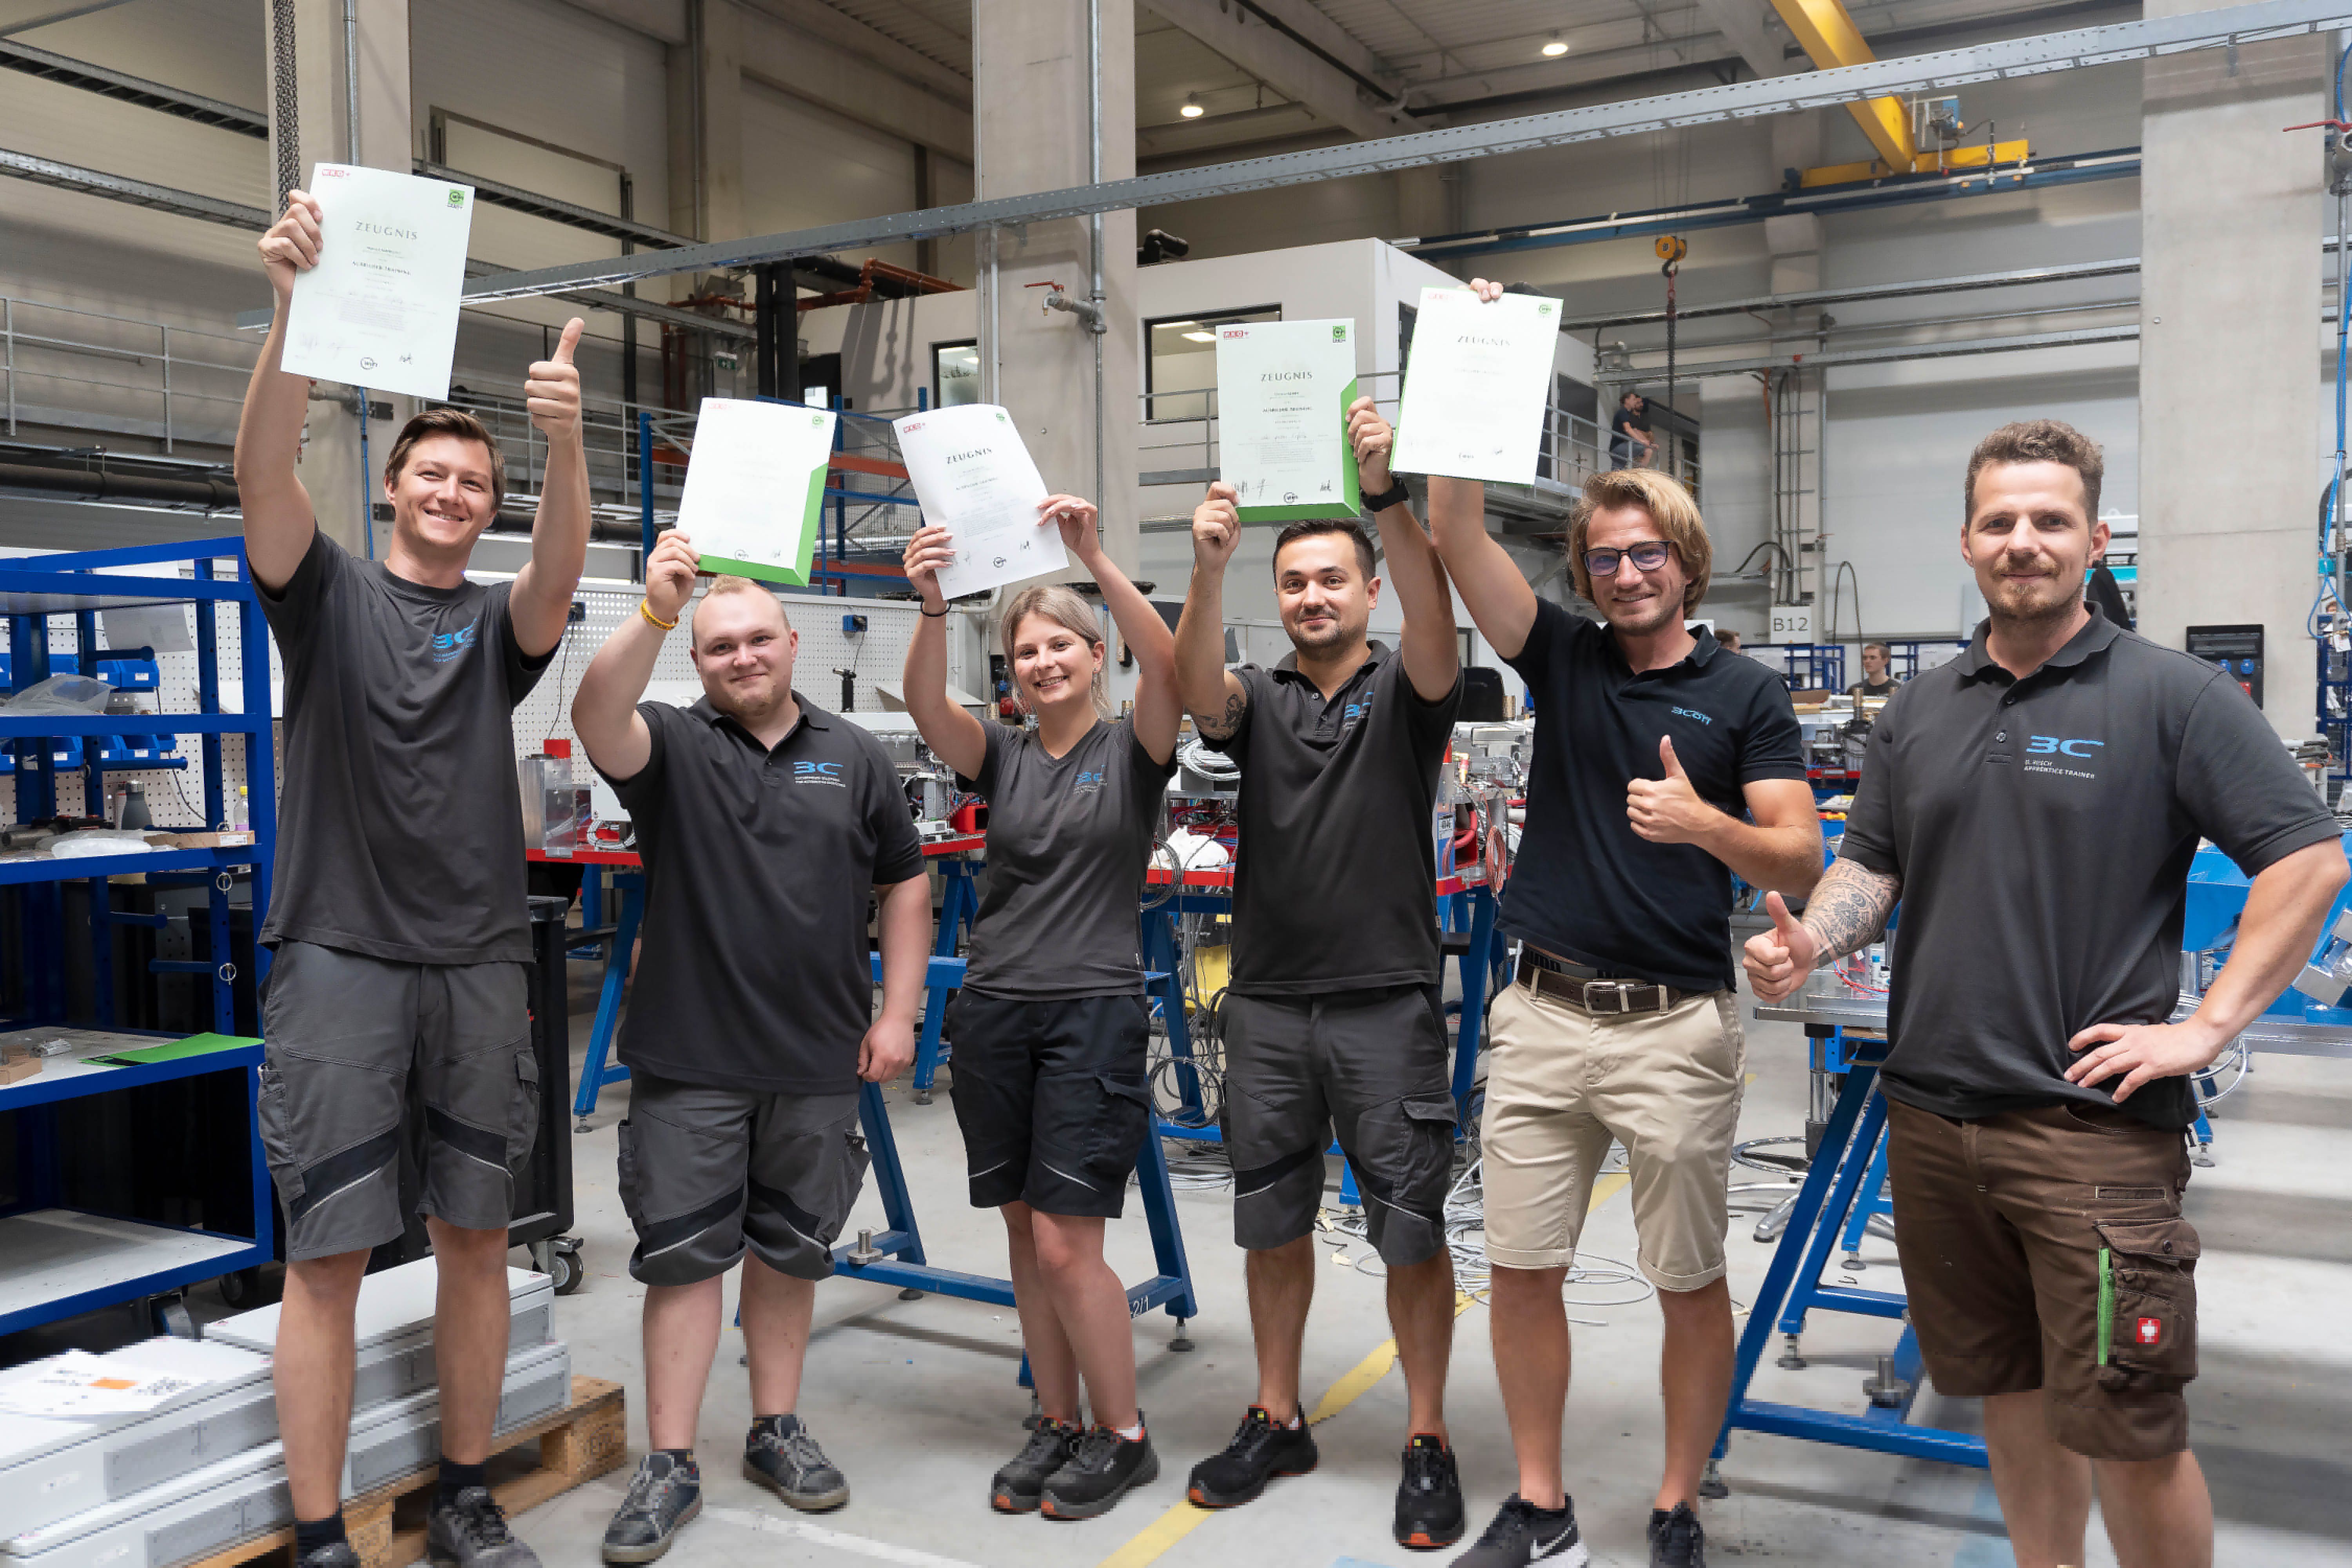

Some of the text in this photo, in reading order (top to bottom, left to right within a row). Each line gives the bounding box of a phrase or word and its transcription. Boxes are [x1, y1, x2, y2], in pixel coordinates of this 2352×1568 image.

[355, 221, 418, 240] ZEUGNIS
[1261, 371, 1313, 383] ZEUGNIS
[946, 448, 993, 465] ZEUGNIS
[1773, 617, 1808, 632] B12
[2025, 735, 2105, 759] 3C
[793, 761, 844, 775] 3C
